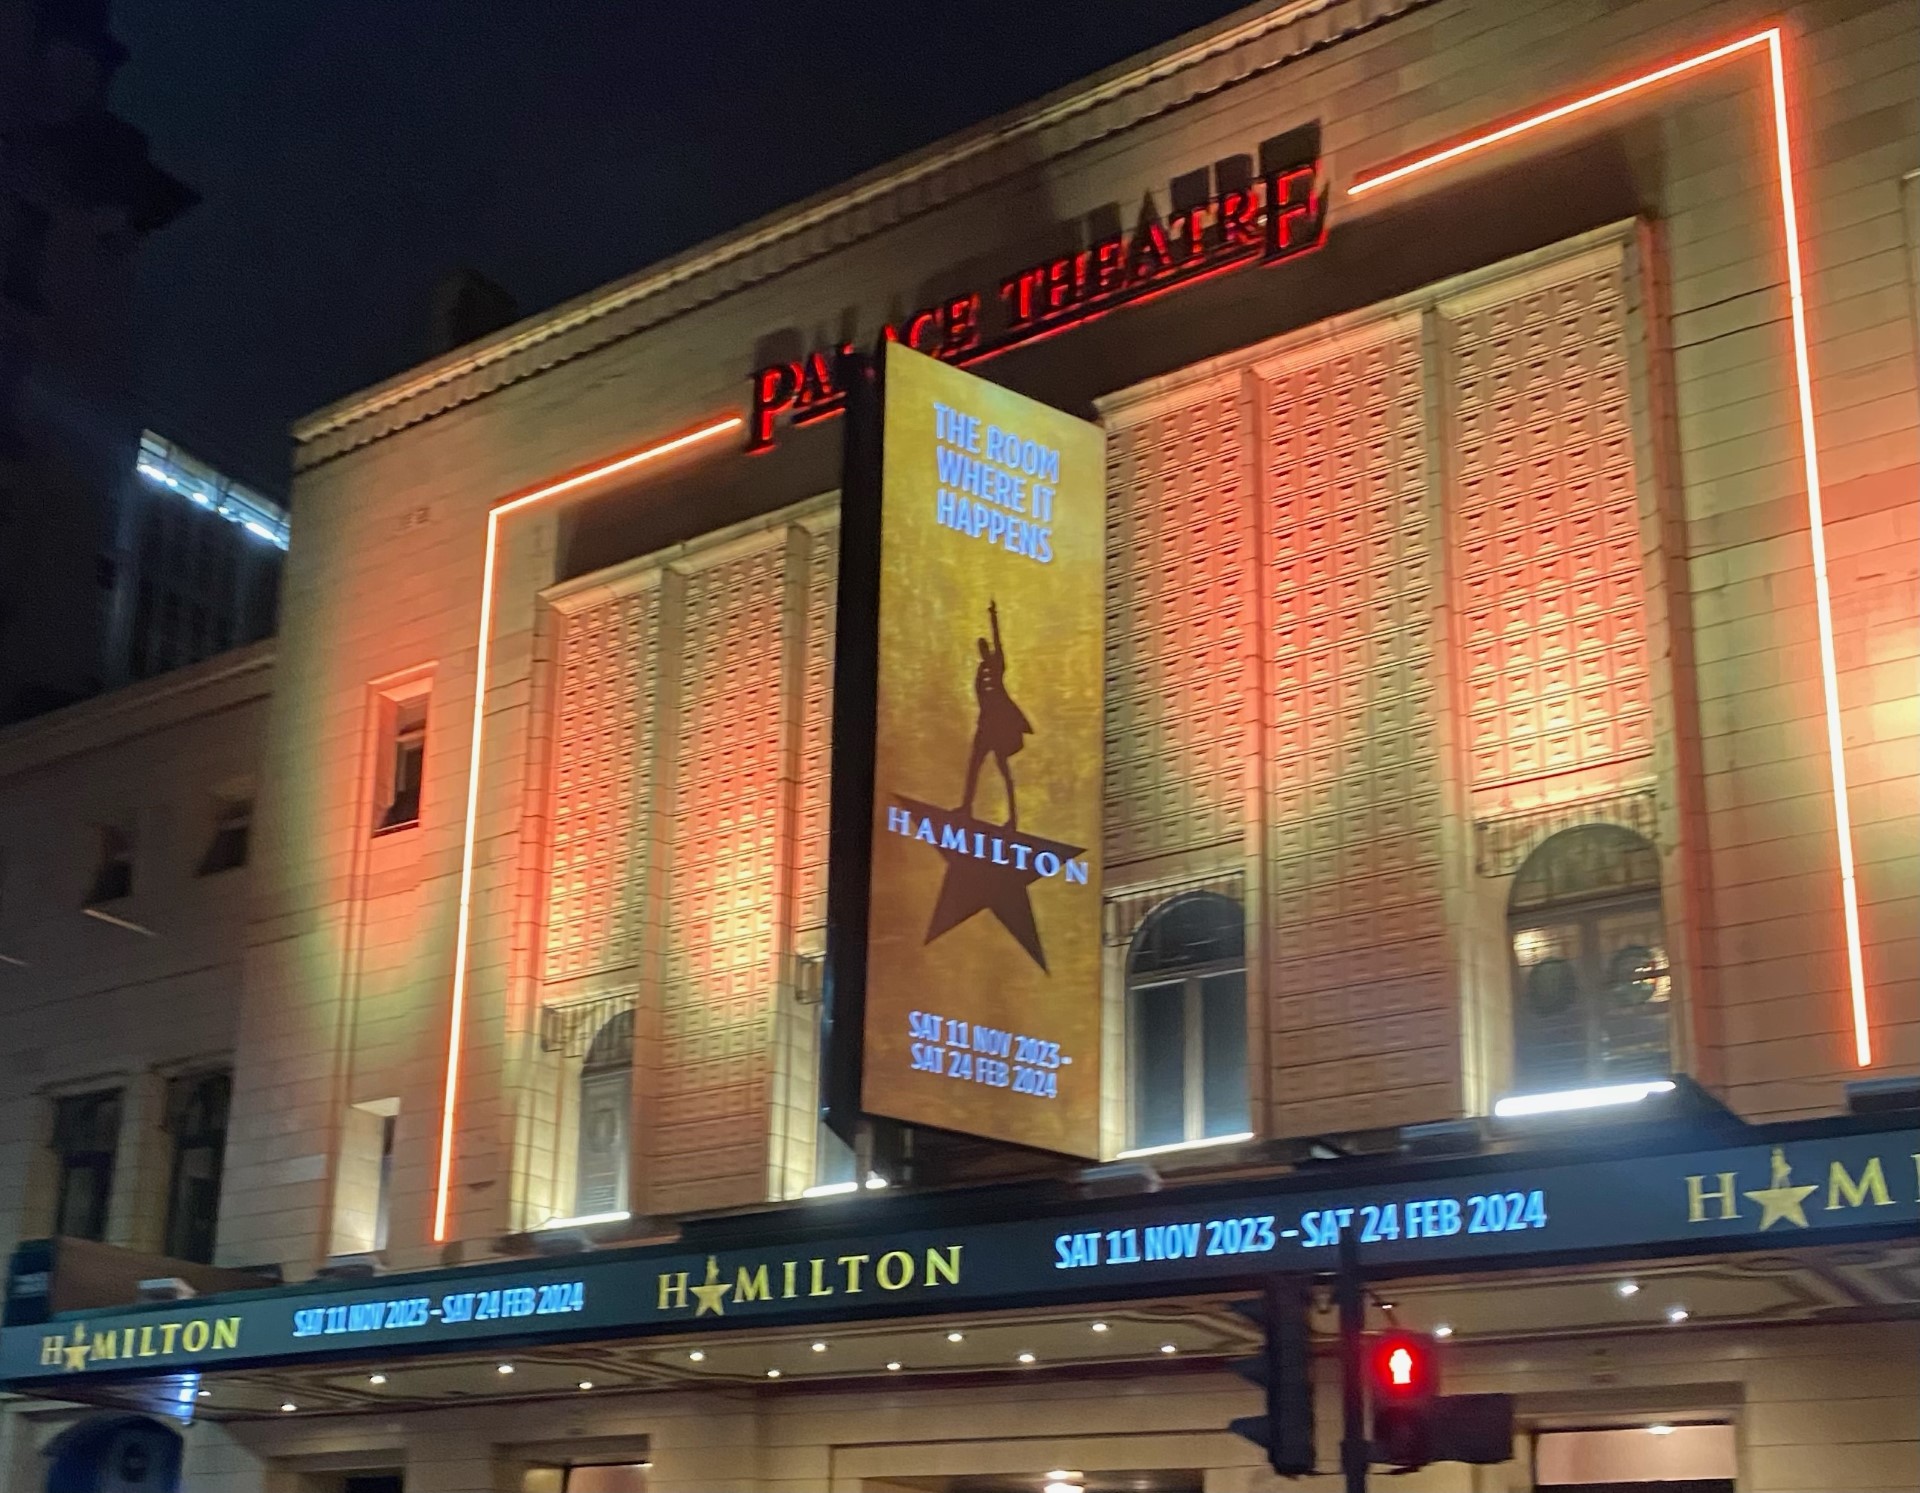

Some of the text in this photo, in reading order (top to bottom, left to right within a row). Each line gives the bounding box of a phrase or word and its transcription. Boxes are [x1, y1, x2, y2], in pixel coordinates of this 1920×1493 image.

[746, 160, 1331, 456] PACE THEATRE
[933, 402, 1060, 484] THE ROOM
[936, 445, 1056, 522] WHERE IT
[937, 489, 1053, 563] HAPPENS
[887, 806, 1089, 885] HAMILTON
[908, 1010, 944, 1042] SAT
[945, 1019, 970, 1050] 11
[972, 1024, 1013, 1059] NOV
[910, 1042, 1059, 1099] SAT 24 FEB 2024
[1055, 1231, 1102, 1269] SAT
[1105, 1228, 1141, 1265] 11
[1144, 1222, 1201, 1262] NOV
[1205, 1215, 1276, 1256] 2023
[1300, 1207, 1355, 1248] SAT
[1360, 1203, 1400, 1243] 24
[1405, 1199, 1463, 1240] FEB
[1467, 1190, 1548, 1234] 2024
[292, 1307, 327, 1337] SAT
[324, 1305, 348, 1334] 11
[440, 1292, 477, 1324] SAT
[474, 1290, 502, 1320] 24
[500, 1287, 537, 1318] FEB
[535, 1281, 585, 1315] 2024
